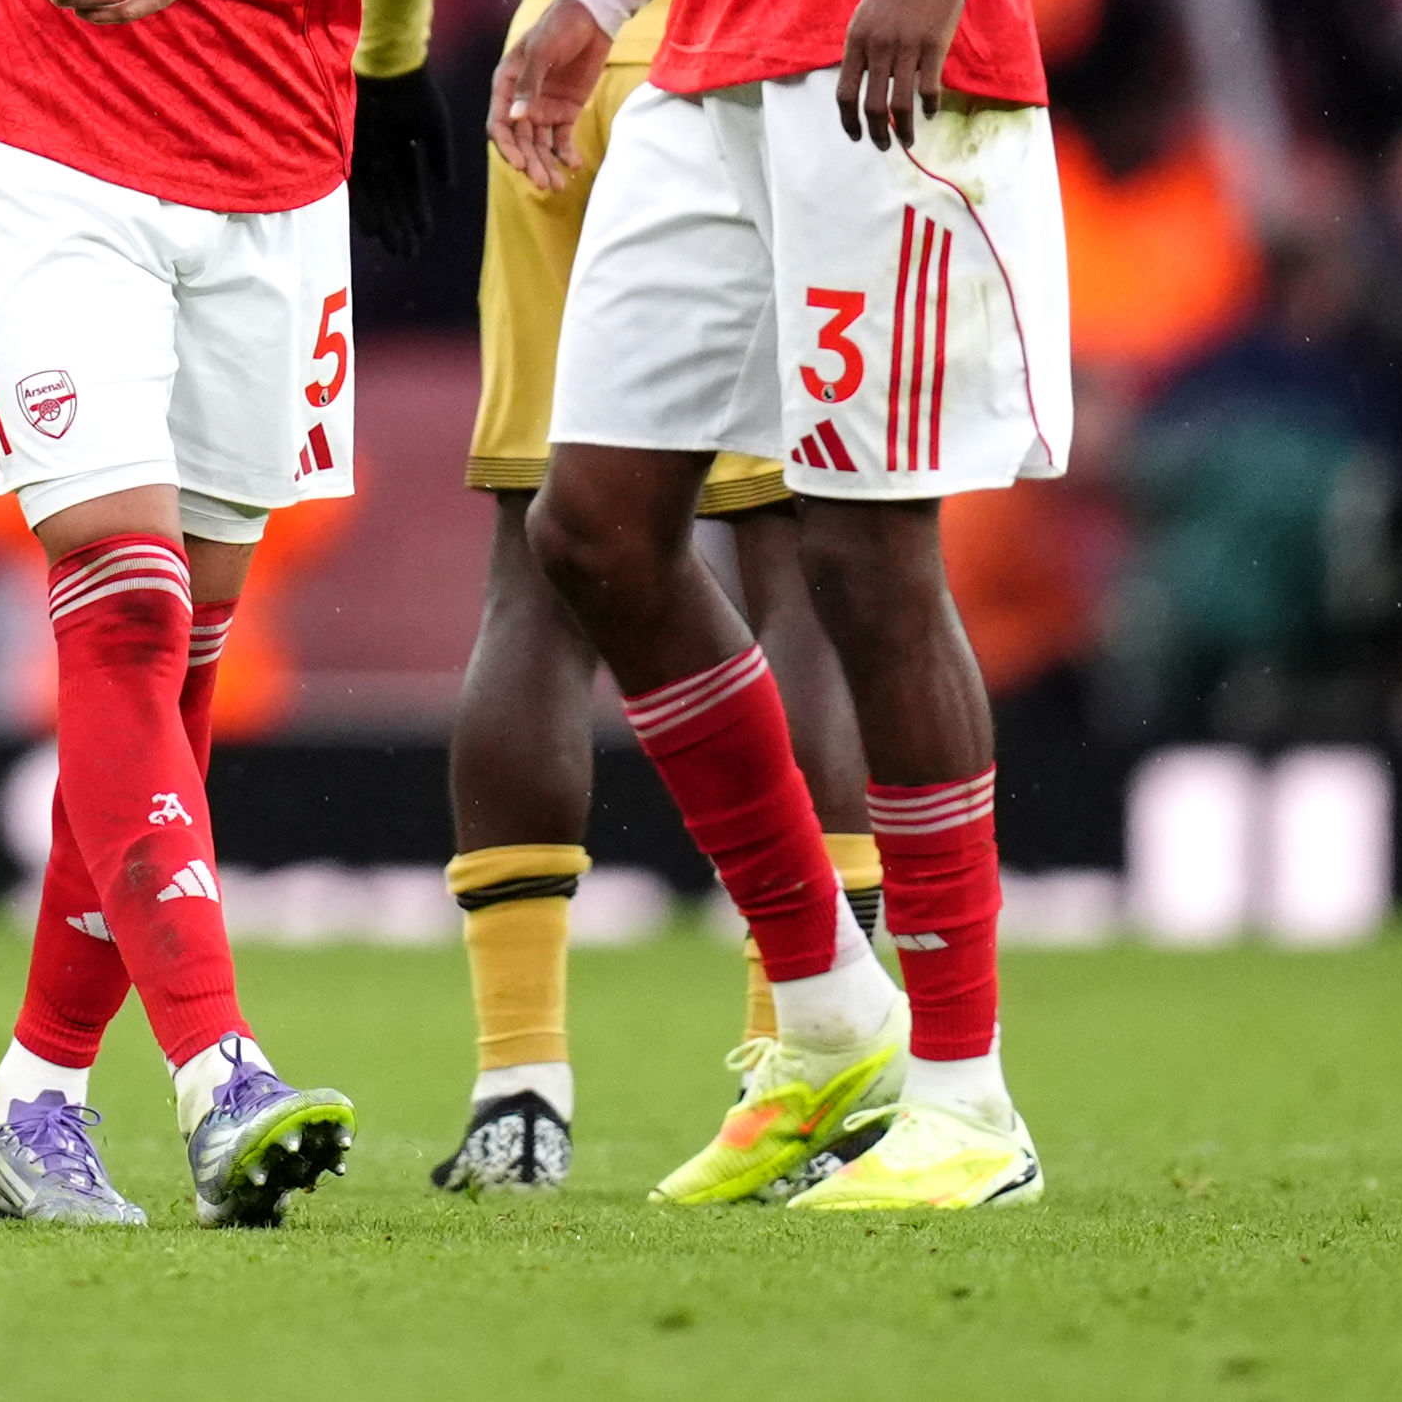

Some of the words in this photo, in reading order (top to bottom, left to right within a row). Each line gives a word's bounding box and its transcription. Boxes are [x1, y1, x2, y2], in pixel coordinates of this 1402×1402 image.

[24, 379, 65, 400] Arsenal
[304, 285, 348, 408] 5
[799, 286, 865, 404] 3
